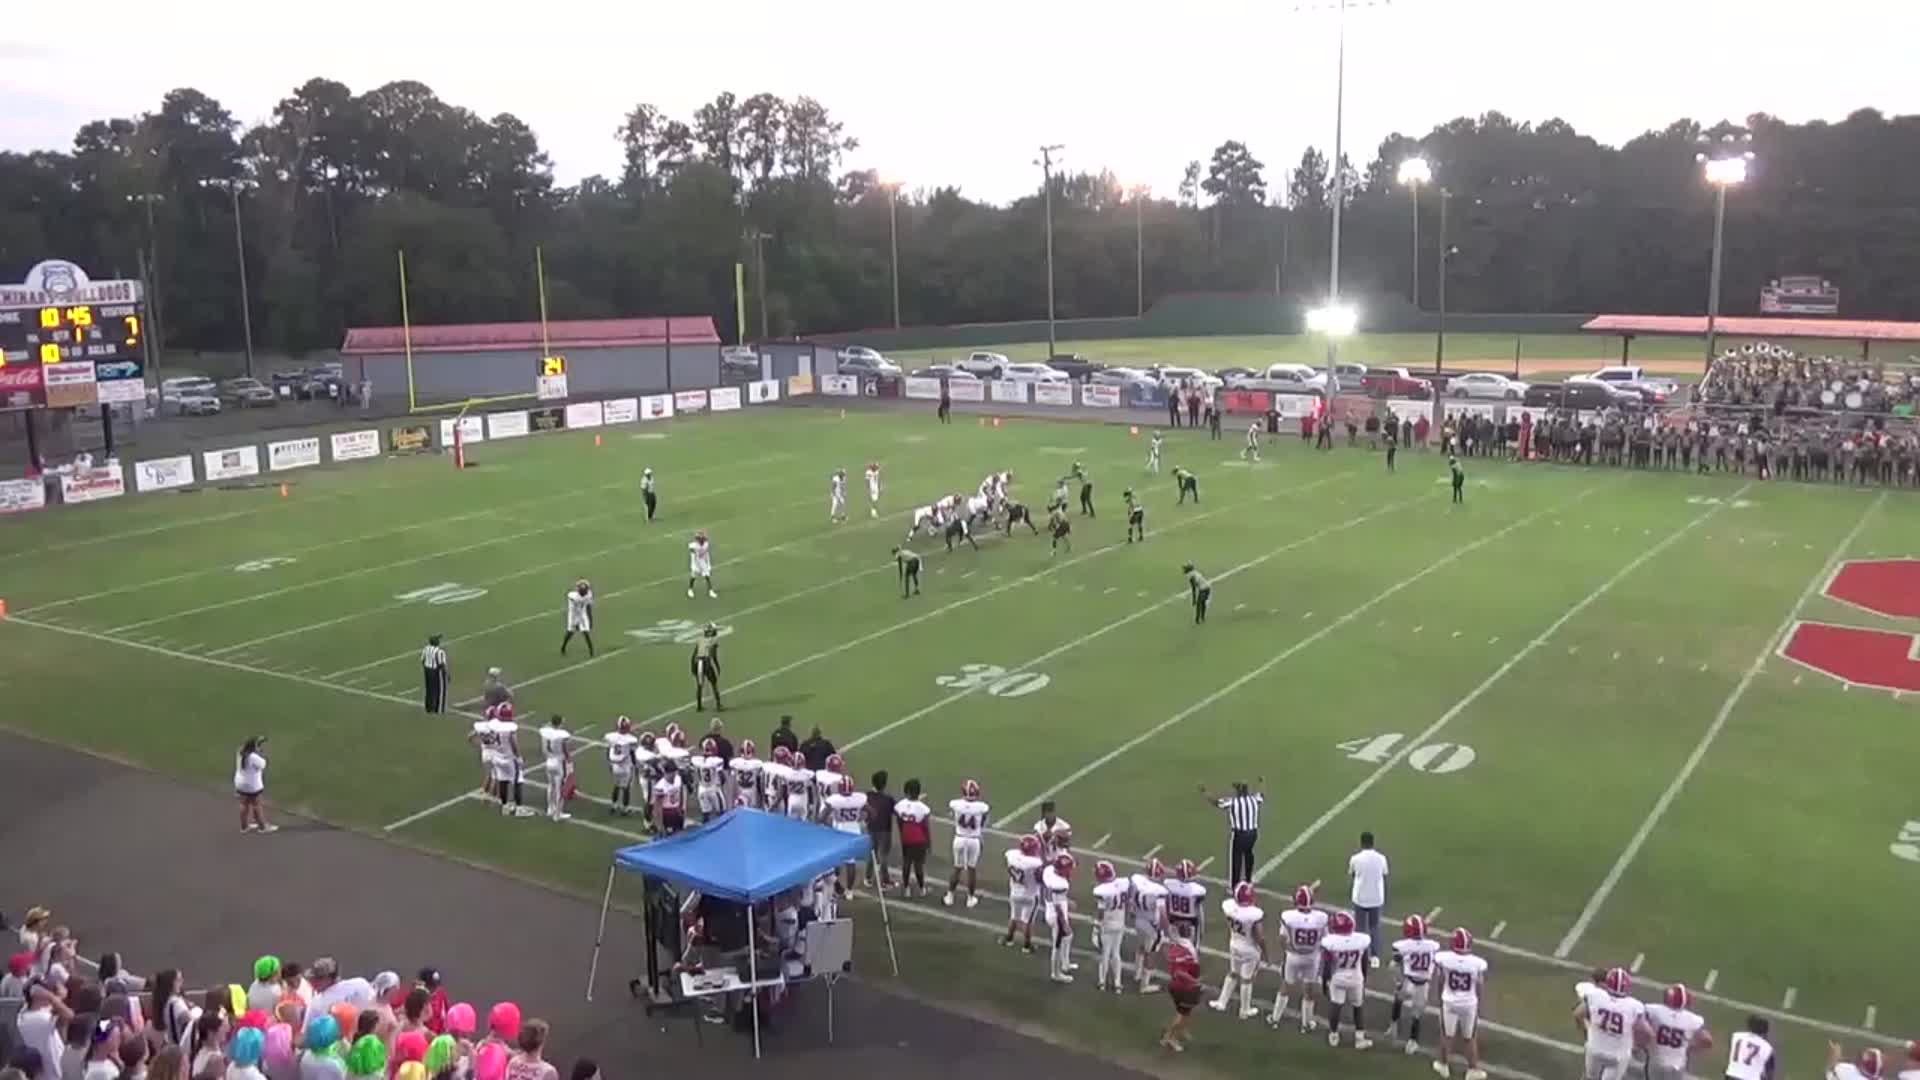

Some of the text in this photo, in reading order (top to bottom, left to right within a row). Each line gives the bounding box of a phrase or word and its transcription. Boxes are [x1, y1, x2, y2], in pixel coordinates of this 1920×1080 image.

[41, 343, 60, 364] 10
[543, 357, 563, 377] 24
[935, 663, 1051, 697] 30
[1336, 732, 1476, 774] 40
[958, 813, 977, 831] 44
[1733, 1038, 1761, 1065] 17
